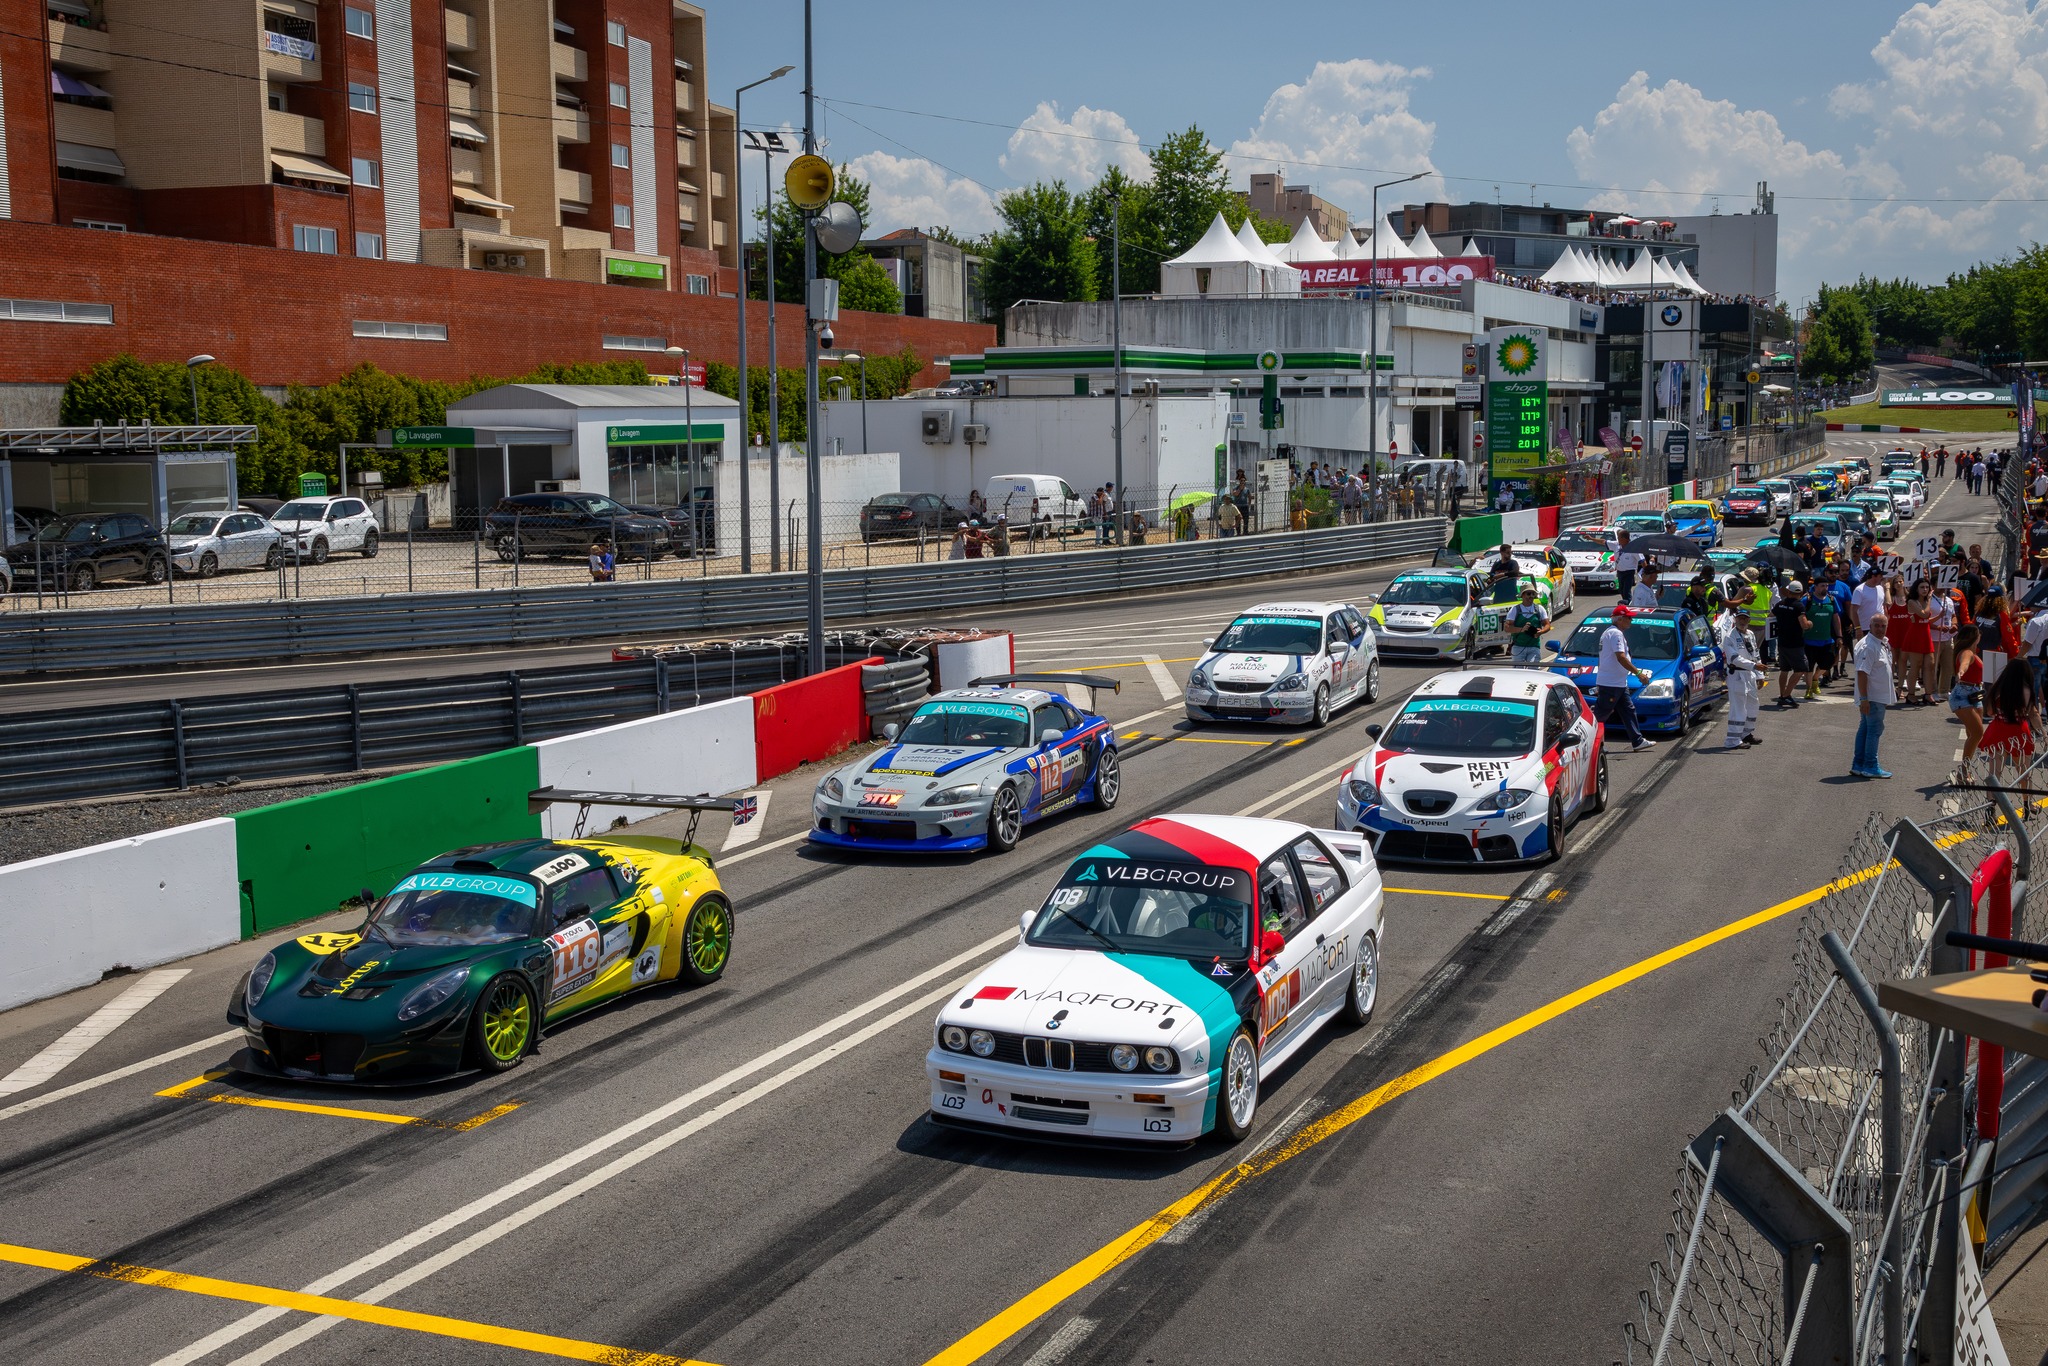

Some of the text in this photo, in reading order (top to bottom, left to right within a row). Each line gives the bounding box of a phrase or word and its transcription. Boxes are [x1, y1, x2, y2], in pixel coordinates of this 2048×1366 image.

[1314, 267, 1360, 283] REAL
[1402, 265, 1474, 287] 100
[1530, 328, 1541, 336] bp
[1504, 383, 1538, 393] shop
[1921, 391, 1995, 401] 100
[409, 431, 442, 440] Lavagem
[618, 429, 641, 438] Lavagem
[1916, 537, 1938, 555] 13
[1878, 556, 1899, 573] 14
[1905, 564, 1922, 581] 11
[1940, 565, 1959, 583] 12
[1479, 615, 1497, 630] 169
[872, 768, 935, 777] apexstore.pt
[1467, 761, 1511, 771] RENT
[1044, 764, 1059, 791] 112
[859, 793, 905, 806] STIX
[1040, 794, 1077, 816] apexstore.pt
[550, 858, 577, 873] 100
[1049, 888, 1084, 906] 108
[563, 926, 583, 940] moura
[553, 937, 599, 984] 118
[1301, 934, 1350, 996] MAQFORT
[331, 960, 380, 995] LOTUS
[555, 974, 592, 998] SUPER EXTRA
[1013, 990, 1183, 1017] MAQFORT
[1267, 981, 1289, 1029] 108
